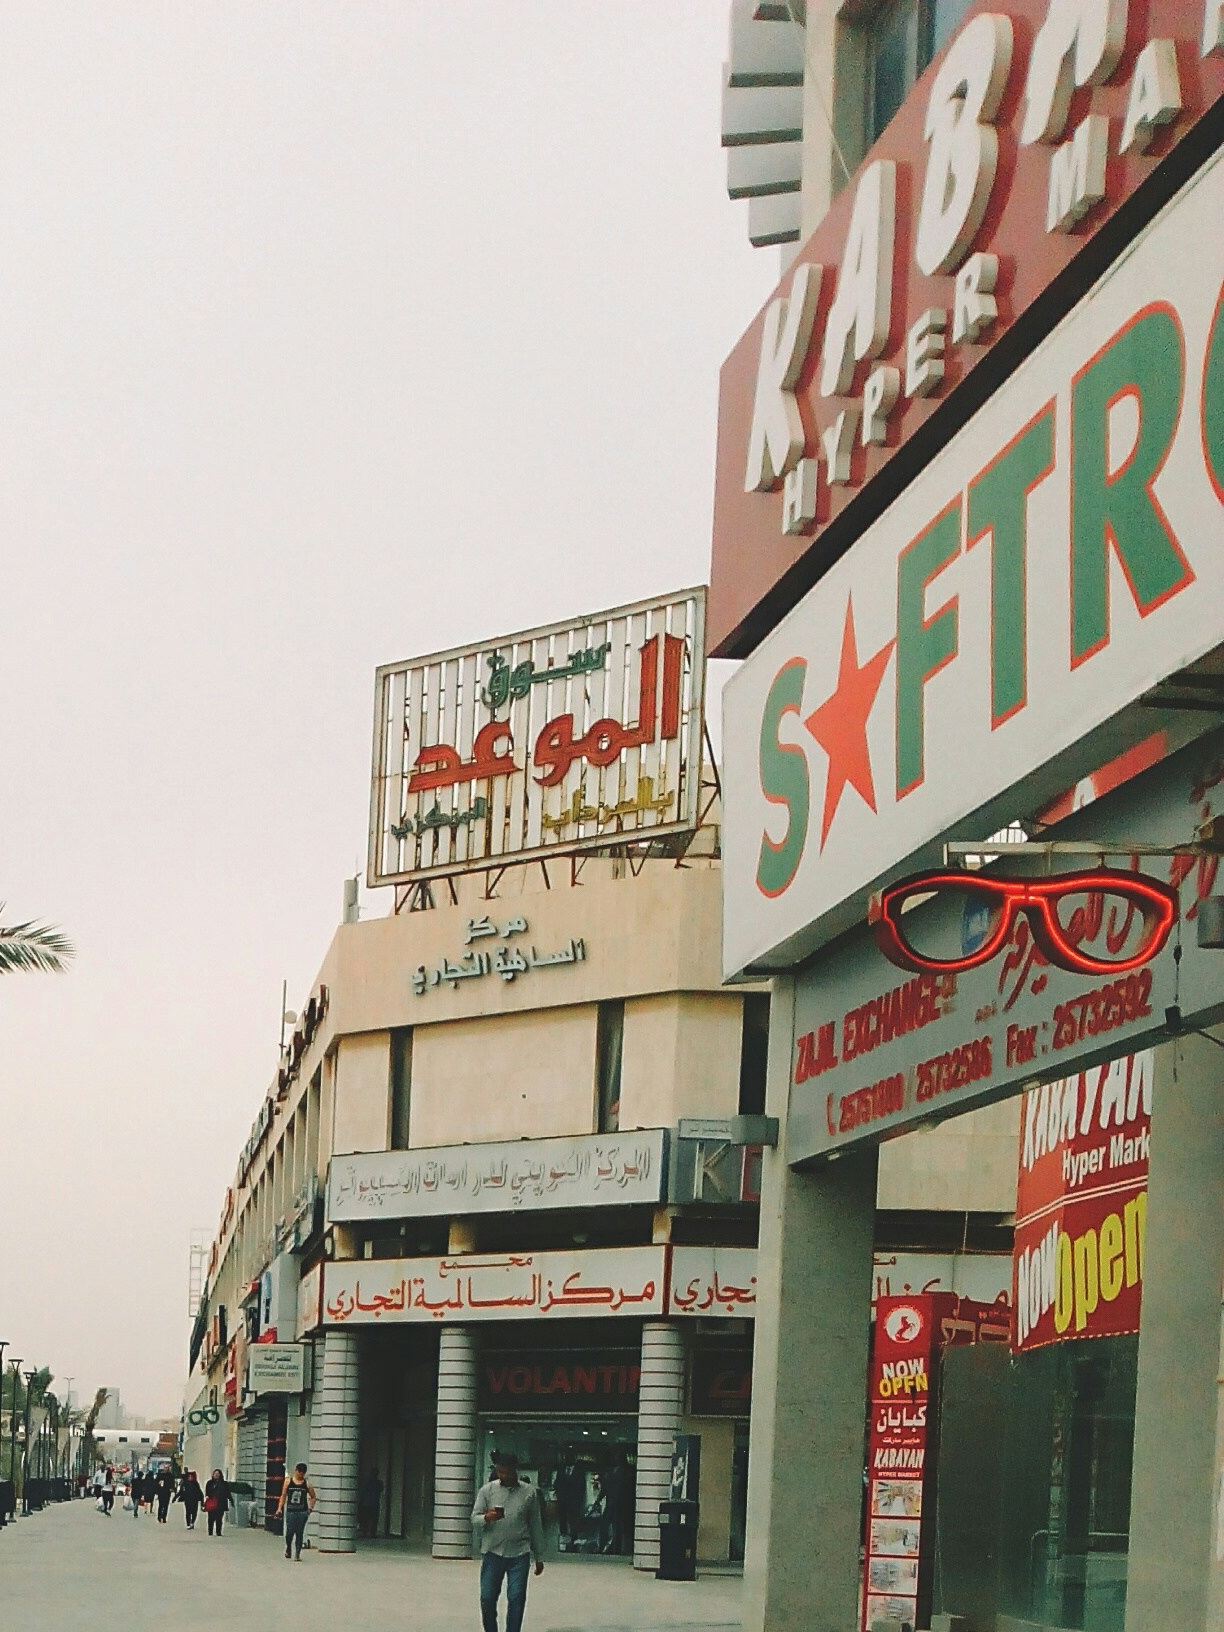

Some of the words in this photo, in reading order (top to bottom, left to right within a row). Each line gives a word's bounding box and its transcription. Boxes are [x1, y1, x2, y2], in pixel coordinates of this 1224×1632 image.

[782, 252, 998, 536] HYPER
[481, 642, 610, 708] سوق
[408, 633, 684, 793] الموعد
[464, 915, 528, 945] مركز
[496, 938, 586, 982] السالمية
[842, 973, 941, 1061] EXCHANGE
[1062, 1145, 1107, 1188] Hyper
[439, 1256, 533, 1278] مجمع
[327, 1279, 412, 1321] التجاري
[413, 1273, 542, 1319] السالمية
[540, 1272, 656, 1313] مركز
[882, 1357, 924, 1379] NOW
[874, 1448, 925, 1469] KABAYAN
